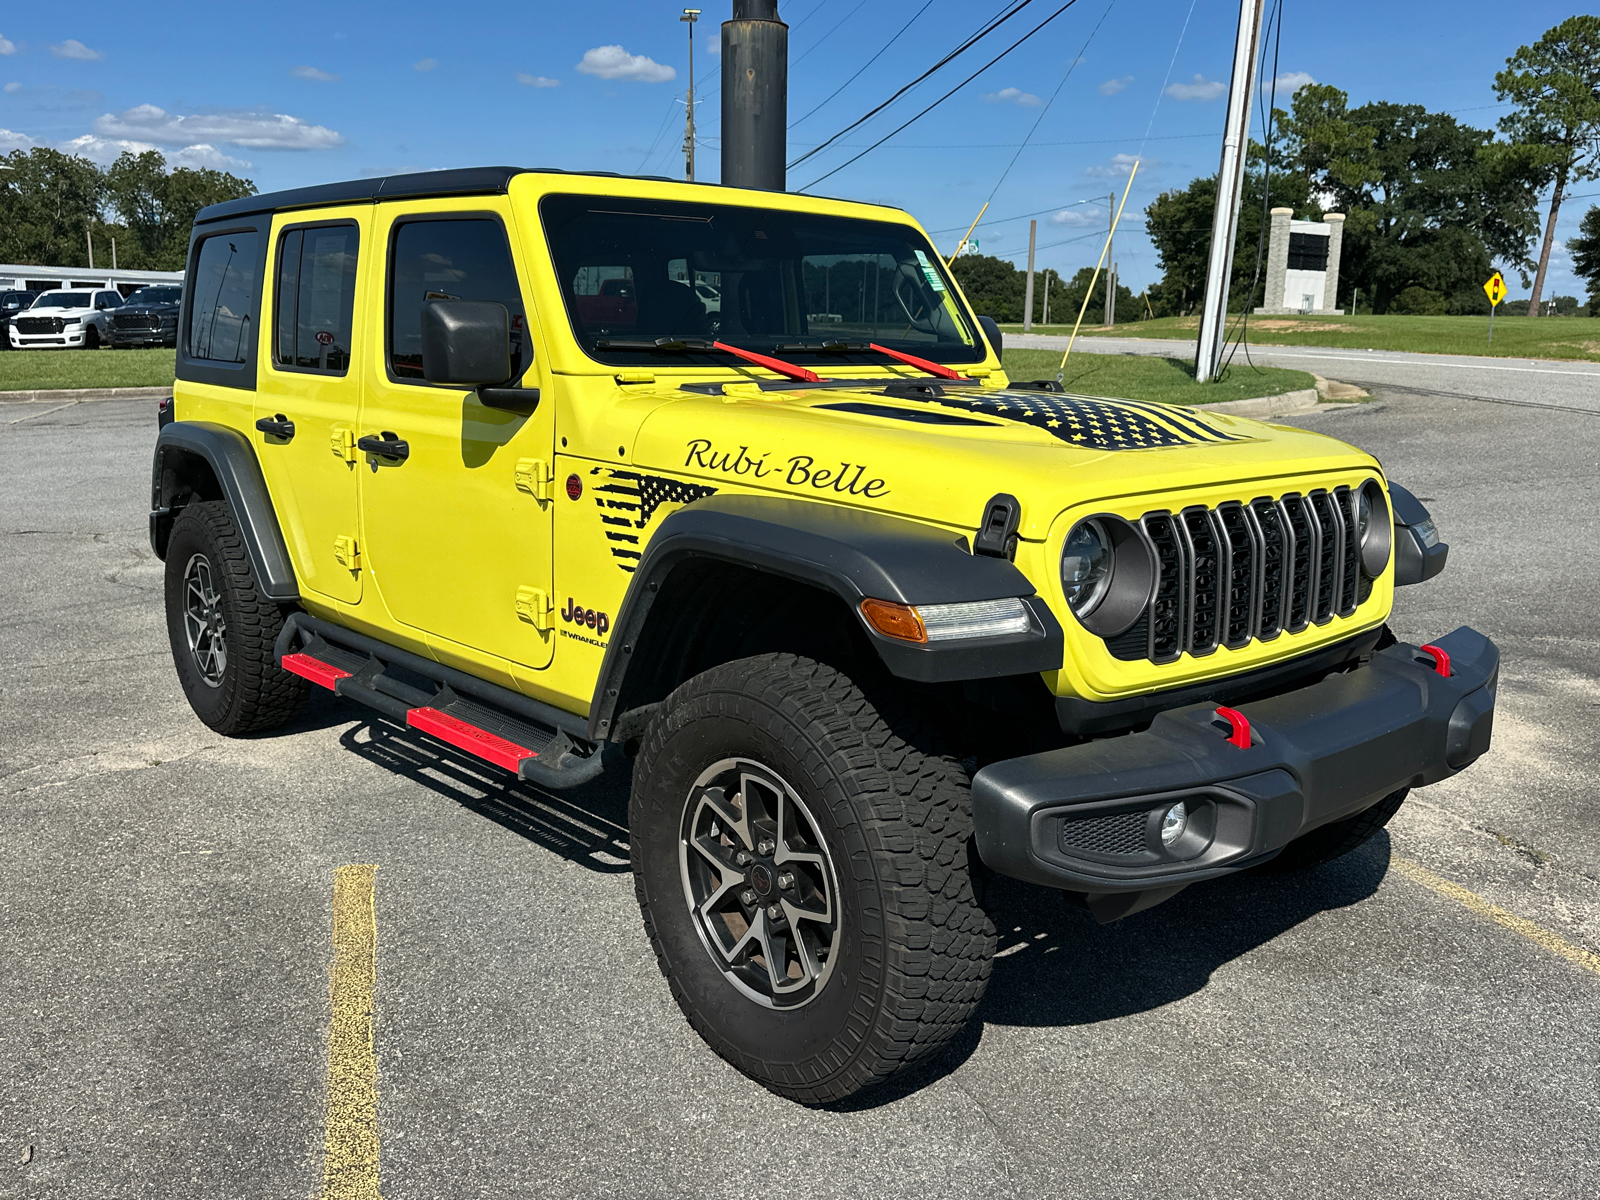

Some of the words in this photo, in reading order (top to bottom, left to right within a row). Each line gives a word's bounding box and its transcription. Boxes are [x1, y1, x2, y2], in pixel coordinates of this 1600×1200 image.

[684, 439, 891, 498] Rubi-Belle
[561, 597, 609, 637] Jeep
[567, 632, 608, 648] WRANGLE
